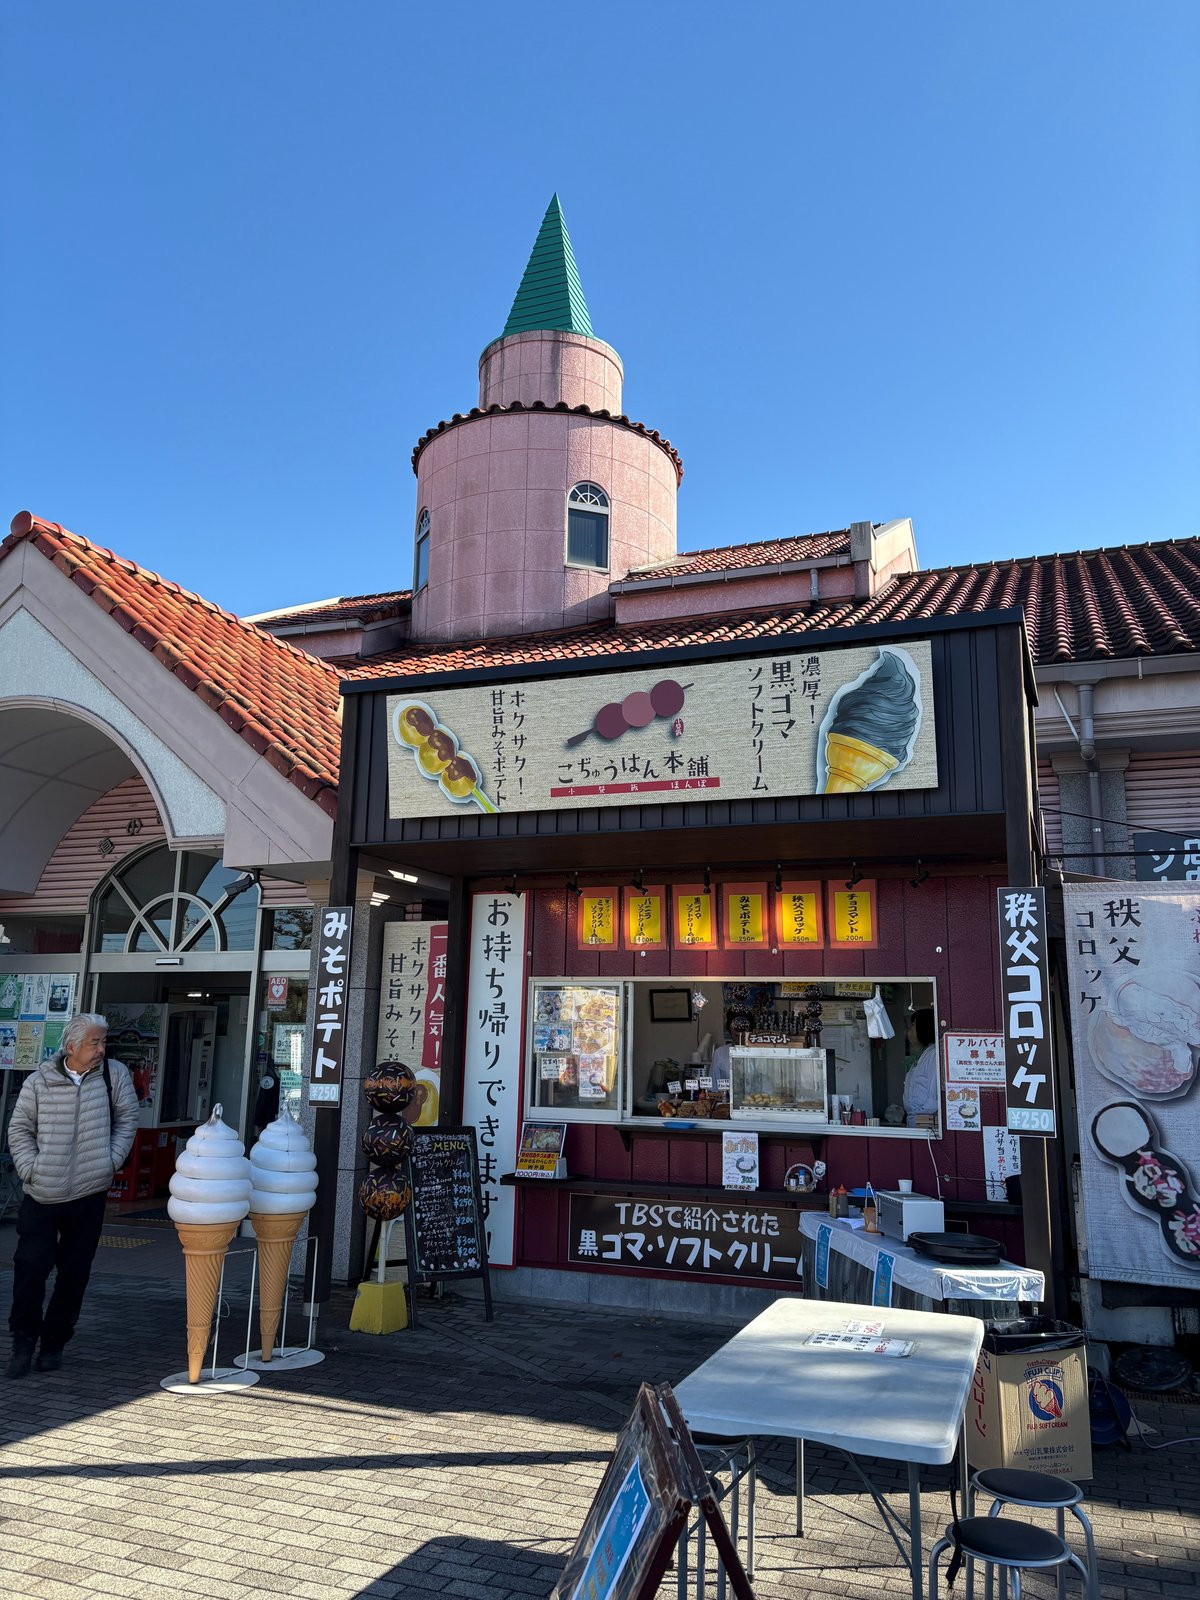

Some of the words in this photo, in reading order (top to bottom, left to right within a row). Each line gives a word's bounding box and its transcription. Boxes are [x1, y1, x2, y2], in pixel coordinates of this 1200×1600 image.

[770, 661, 797, 739] 黒ゴマ
[801, 656, 821, 724] 濃厚！
[490, 689, 507, 805] 甘旨みそポテト
[510, 691, 527, 795] ホクサク！
[748, 667, 768, 790] ソフトクリーム
[558, 751, 709, 784] こぢゅうはん本舗
[671, 779, 707, 790] ほんぽ
[644, 898, 652, 919] バニラ
[686, 903, 694, 936] ソフトクリーム
[694, 897, 702, 919] 黒ゴマ
[739, 896, 750, 935] みそポテト
[792, 895, 804, 934] 秩父コロッケ
[847, 893, 858, 933] チョコマント
[1103, 898, 1142, 966] 秩父
[1076, 911, 1102, 1014] コロッケ
[315, 911, 347, 1078] みそポテト
[408, 937, 426, 1050] ホクサク！
[428, 934, 448, 1065] 一番人気！
[1004, 893, 1046, 1104] 秩父コロッケ
[750, 1034, 790, 1044] チョコマント
[957, 1038, 1004, 1047] アルバイト
[310, 1086, 337, 1100] ¥250
[478, 898, 513, 1259] お持ち帰りできます！
[1011, 1111, 1049, 1129] ¥250
[433, 1141, 465, 1152] MENU
[614, 1202, 780, 1236] TBSで紹介された
[577, 1230, 803, 1276] 黒ゴマ・ソフトクリー
[1028, 1368, 1042, 1377] FUJI
